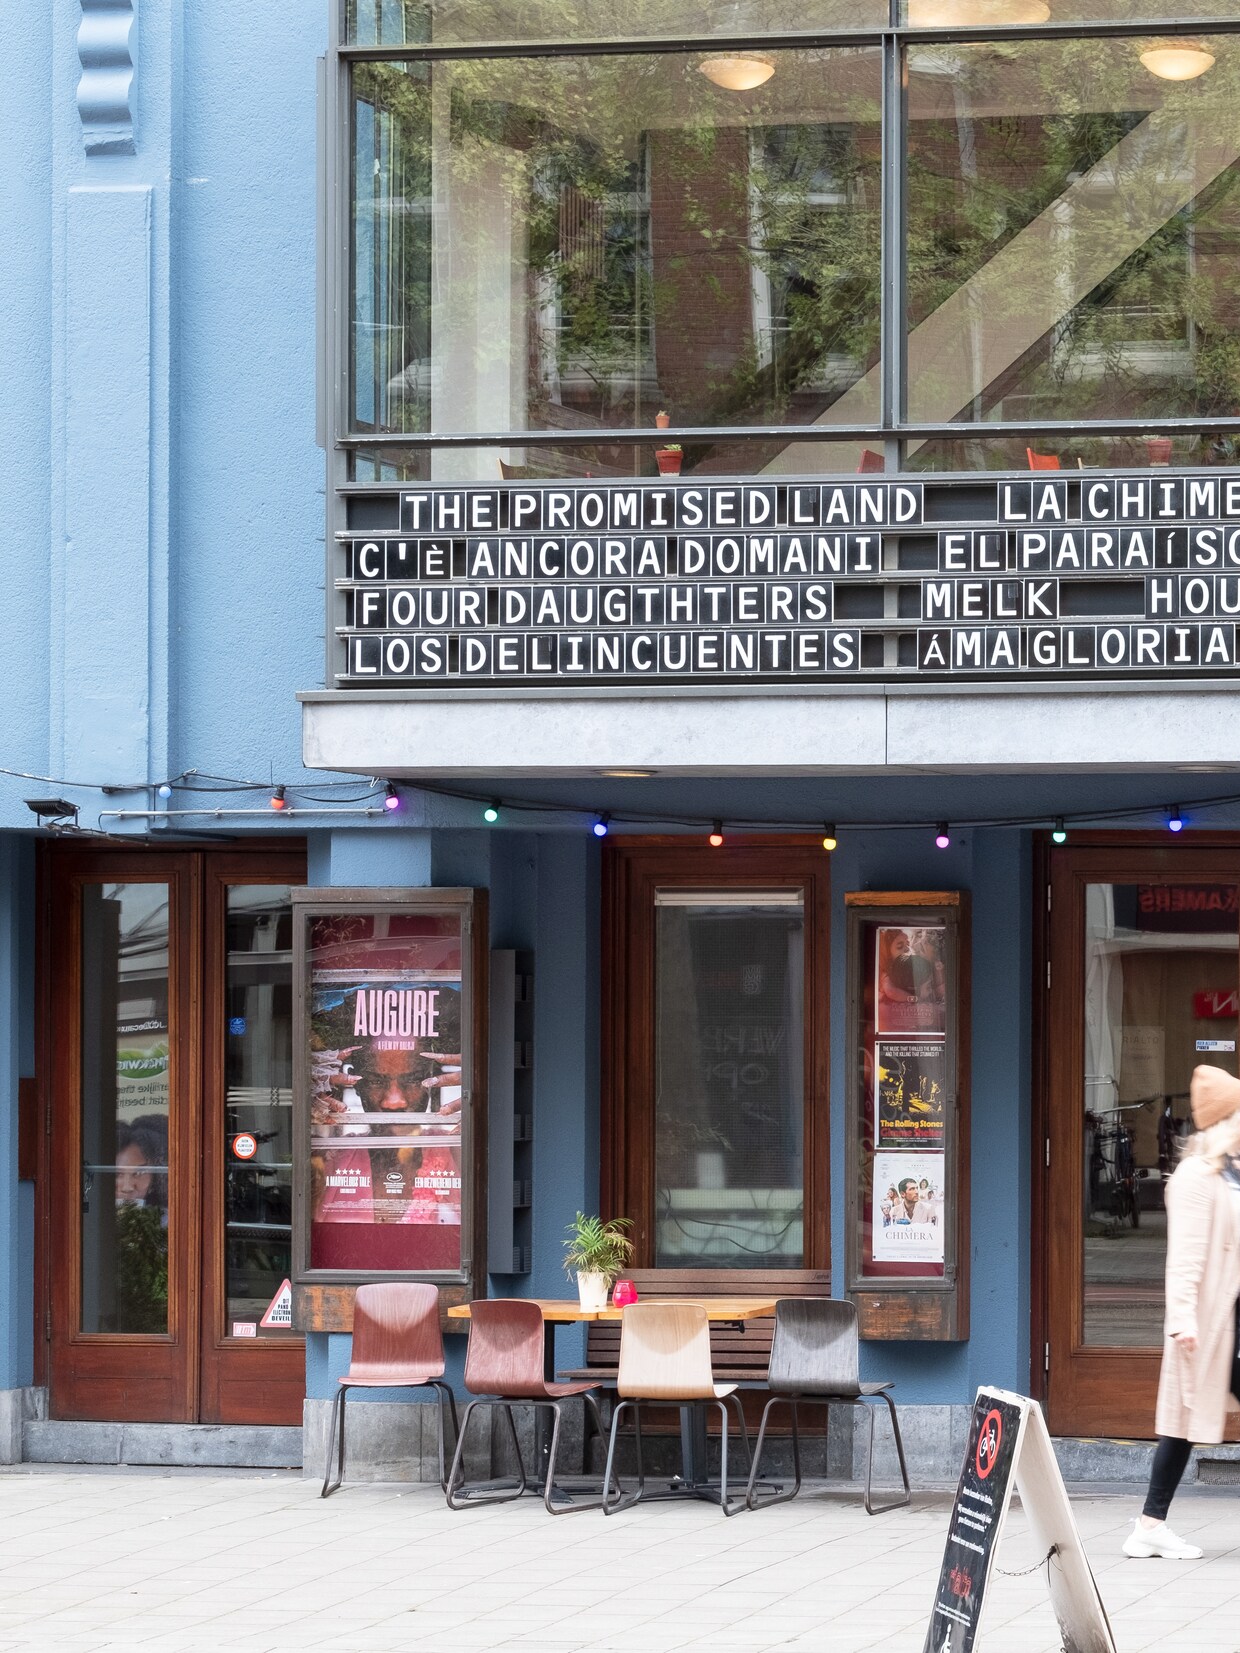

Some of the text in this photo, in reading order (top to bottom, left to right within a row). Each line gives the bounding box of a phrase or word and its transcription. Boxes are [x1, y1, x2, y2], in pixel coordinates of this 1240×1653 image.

[406, 487, 917, 529] THE PROMISED LAND
[1004, 484, 1061, 520] LA
[359, 537, 873, 578] C'È ANCORA DOMANI
[945, 535, 1000, 570] EL
[362, 584, 828, 626] FOUR DAUGTHTERS
[927, 582, 1054, 618] MELK
[356, 632, 855, 674] LOS DELINCUENTES
[1034, 627, 1229, 665] GLORIA
[353, 989, 440, 1037] AUGURE
[895, 1120, 919, 1129] Rolling
[359, 1176, 370, 1187] TALE
[886, 1232, 933, 1240] CHIMERA
